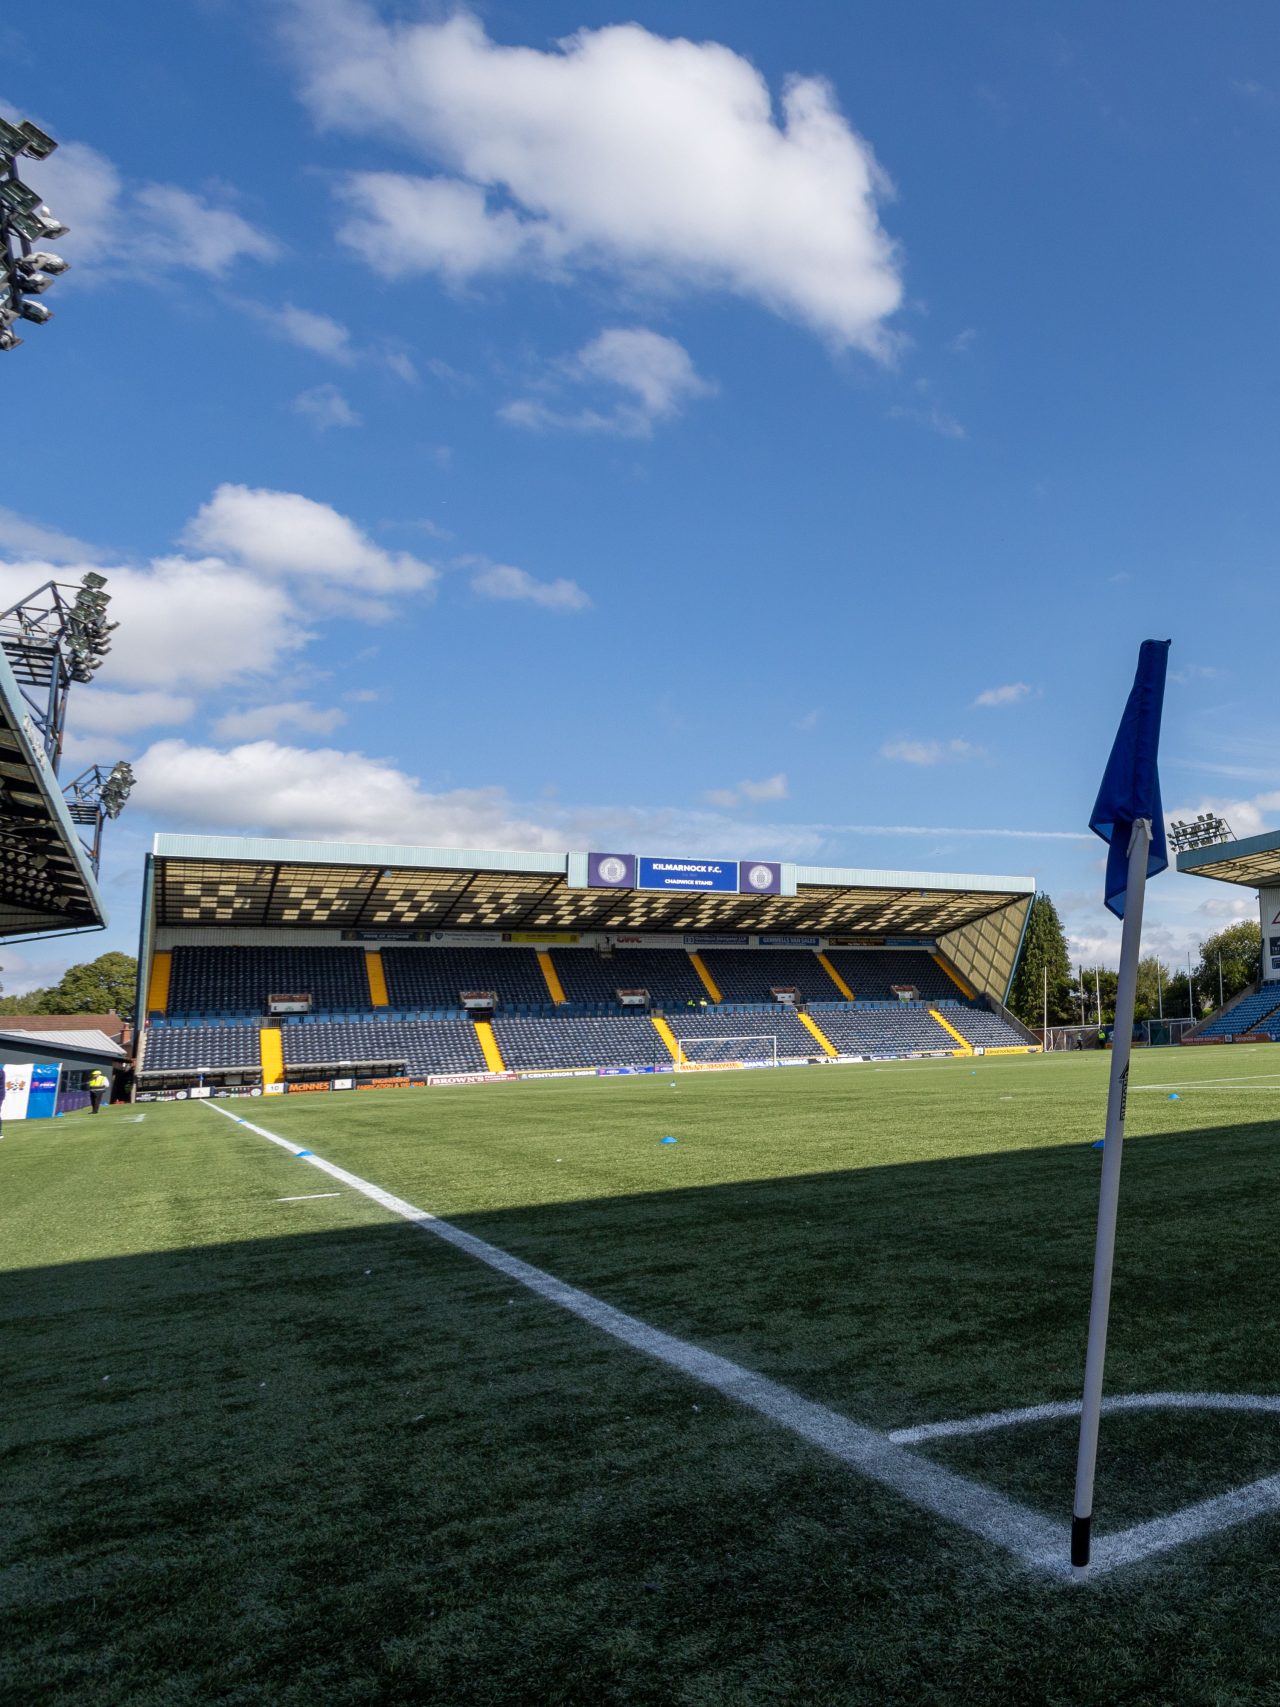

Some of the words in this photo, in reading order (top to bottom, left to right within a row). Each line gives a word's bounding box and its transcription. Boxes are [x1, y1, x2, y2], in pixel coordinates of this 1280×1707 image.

[652, 863, 707, 873] KILMARNOCK
[708, 865, 722, 873] F.C.
[527, 1071, 573, 1079] CENTURION
[432, 1075, 485, 1085] BROWN'S
[289, 1082, 329, 1091] McINNES
